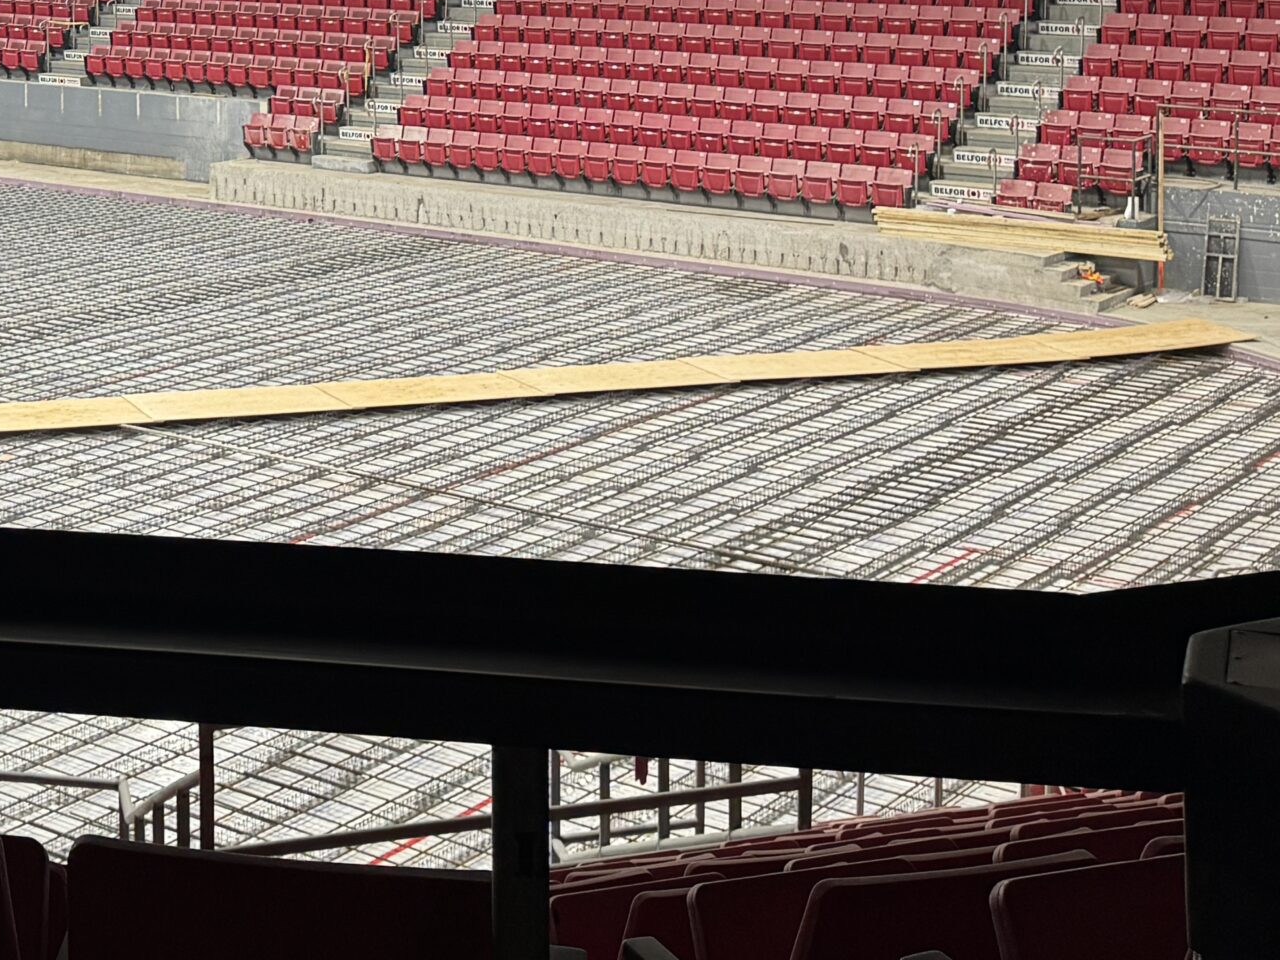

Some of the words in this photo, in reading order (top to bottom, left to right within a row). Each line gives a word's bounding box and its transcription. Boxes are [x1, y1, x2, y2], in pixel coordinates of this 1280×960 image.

[1020, 56, 1050, 64] BELFOR
[1000, 86, 1030, 94] BELFOR
[956, 154, 987, 162] BELFOR
[934, 187, 965, 196] BELFOR
